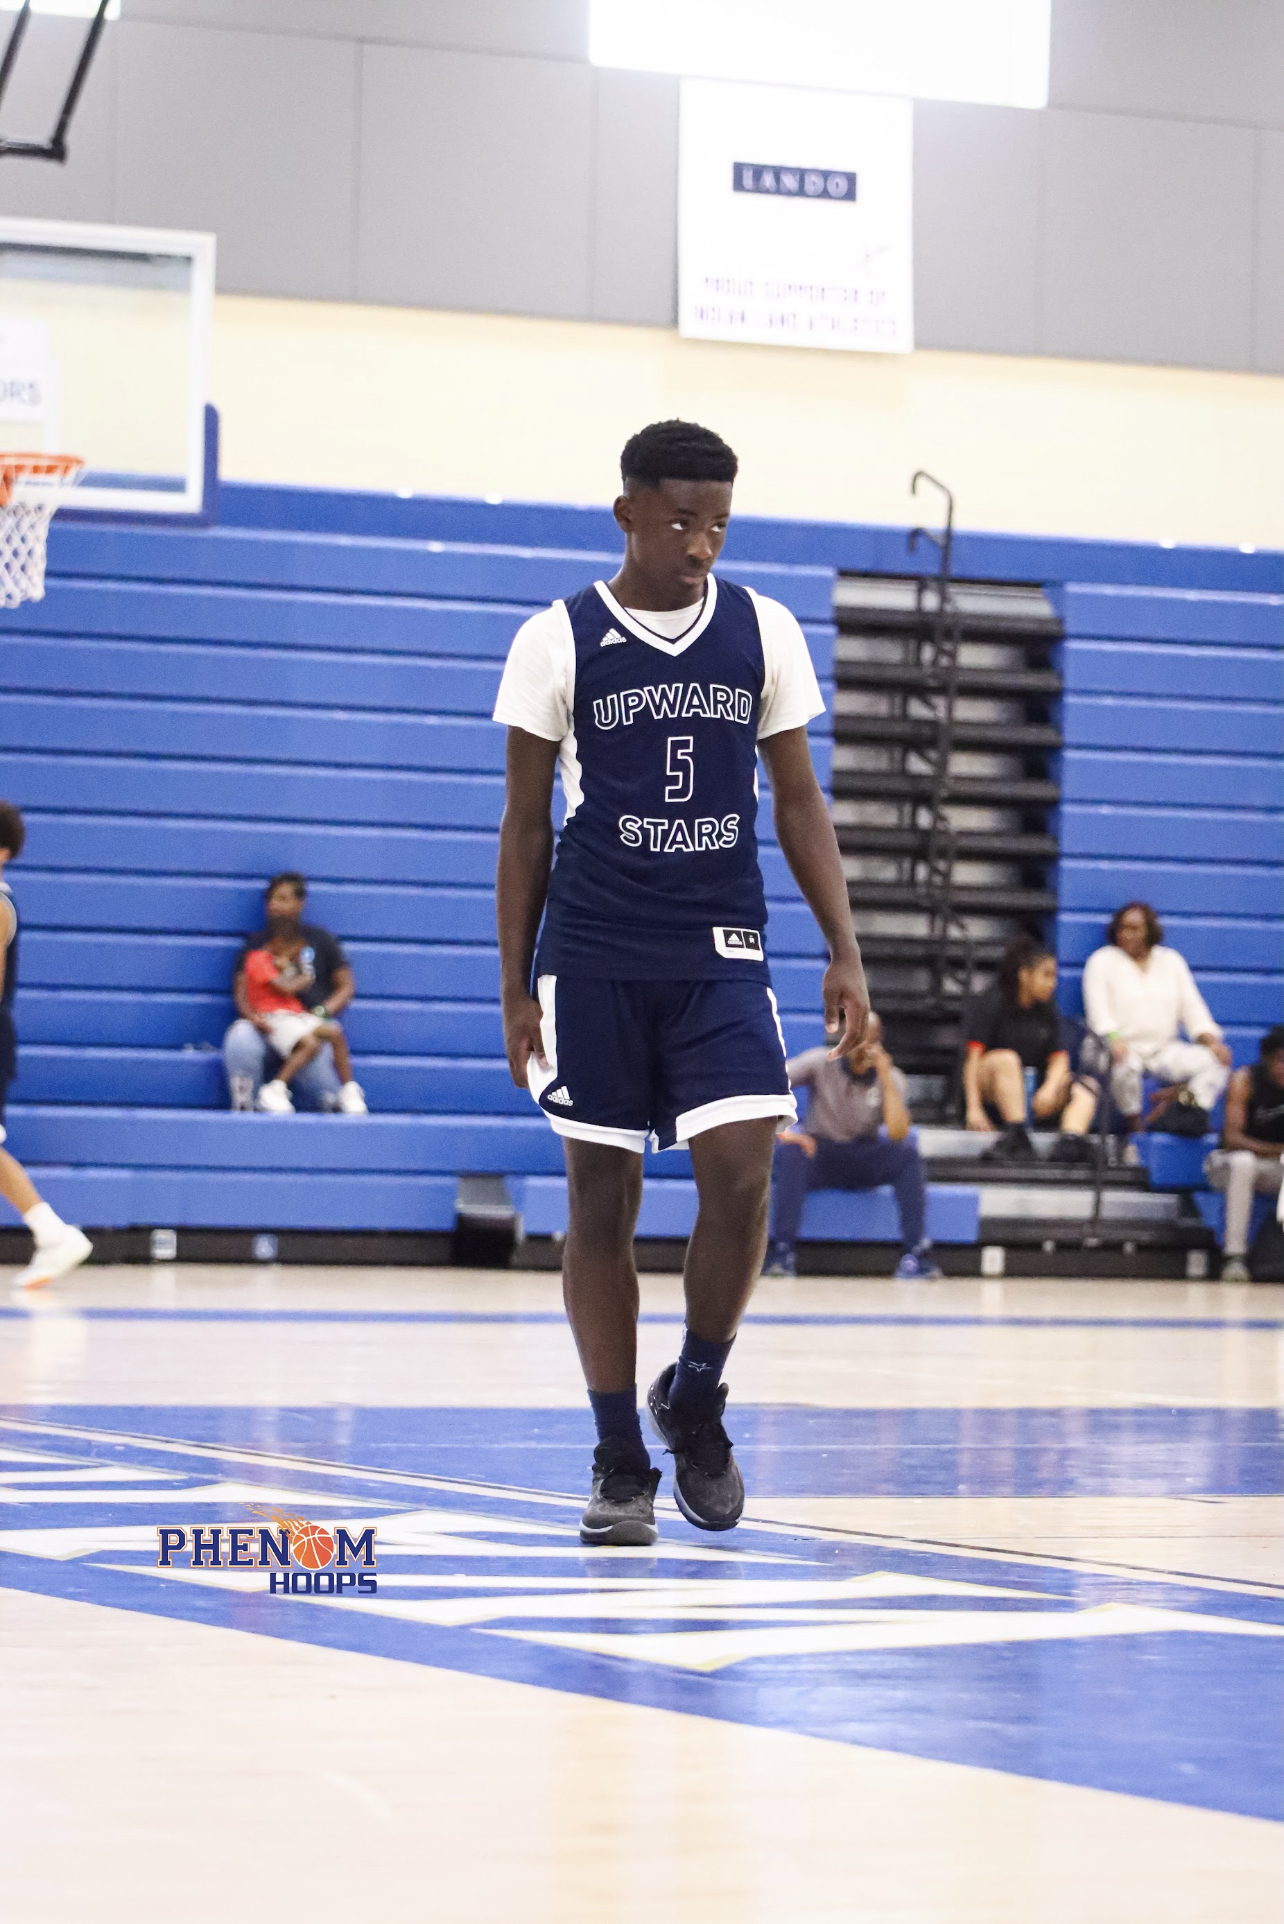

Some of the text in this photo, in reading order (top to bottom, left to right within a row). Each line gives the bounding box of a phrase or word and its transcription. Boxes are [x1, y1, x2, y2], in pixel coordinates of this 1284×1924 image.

[741, 165, 849, 198] LANDO
[593, 683, 752, 730] UPWARD
[665, 736, 694, 802] 5
[619, 814, 740, 852] STARS
